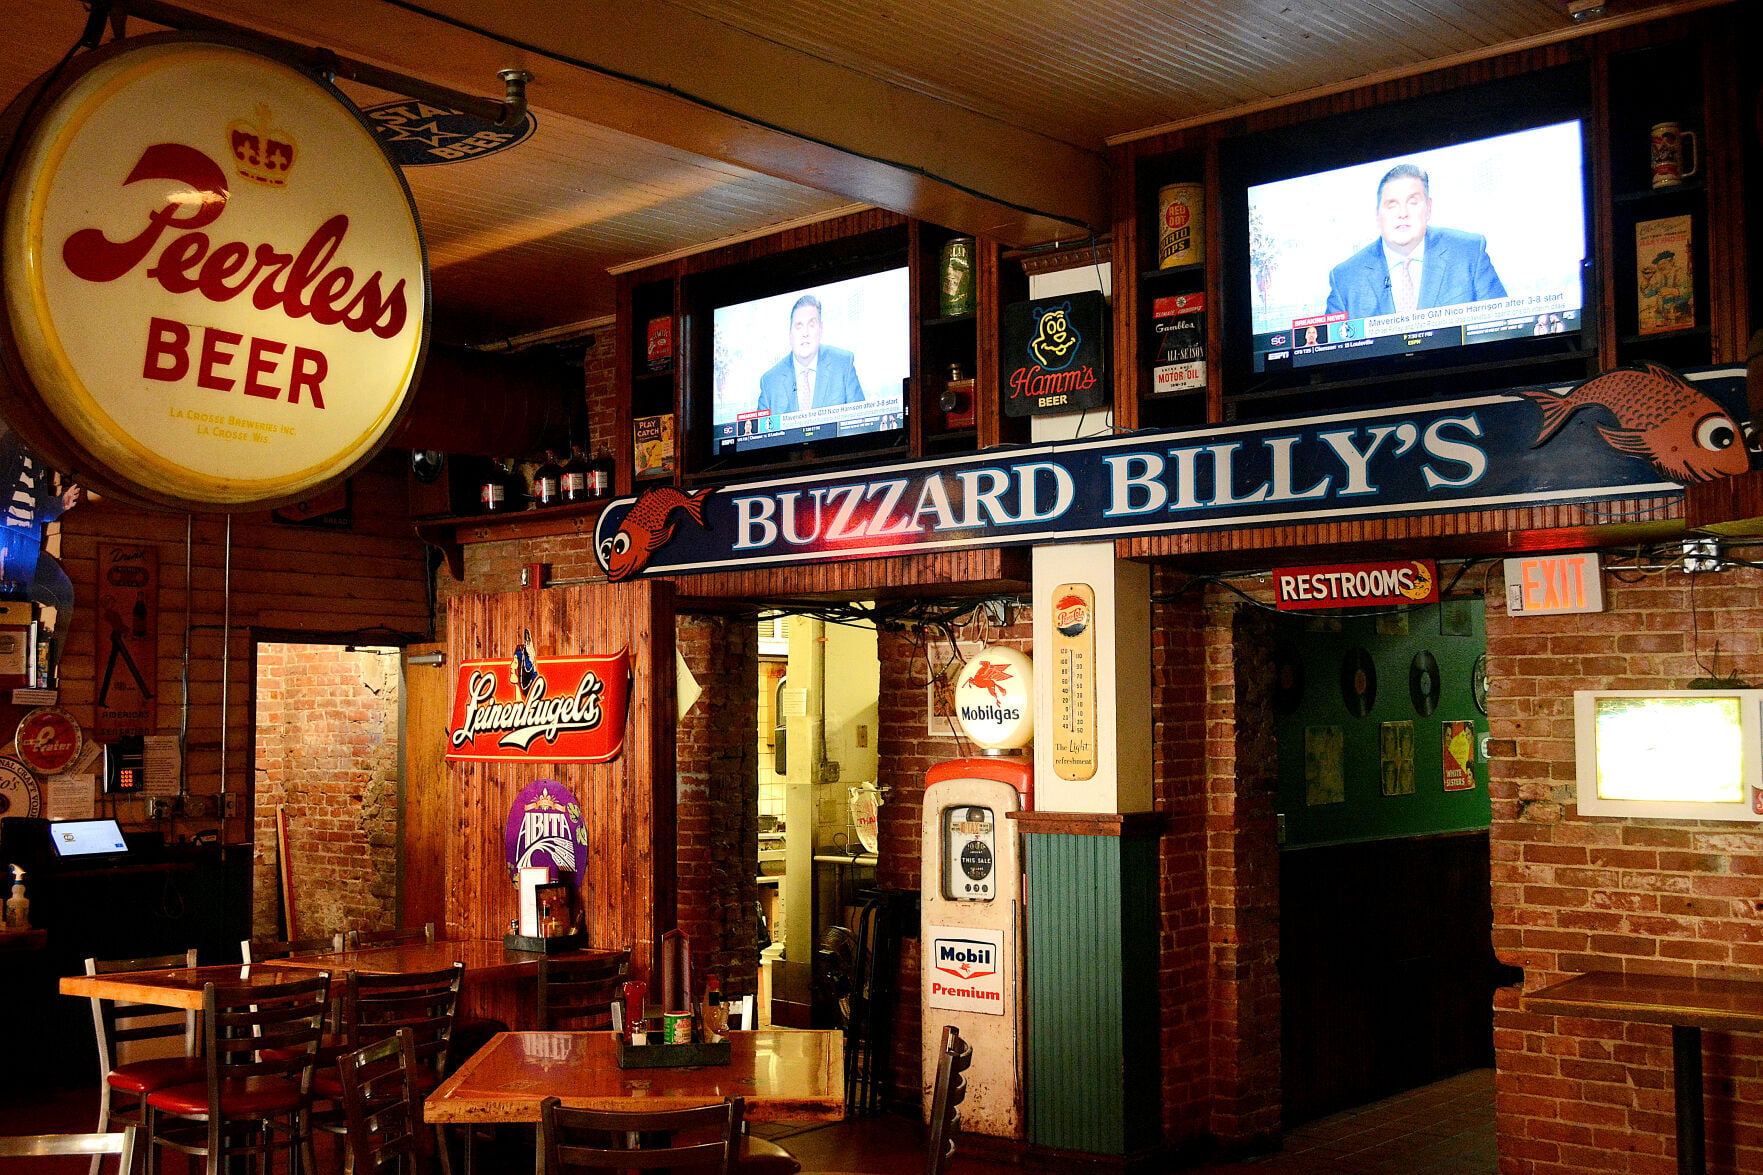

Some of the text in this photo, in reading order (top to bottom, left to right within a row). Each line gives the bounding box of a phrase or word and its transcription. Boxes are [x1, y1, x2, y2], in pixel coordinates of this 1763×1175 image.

[428, 131, 515, 159] BEER
[63, 143, 408, 339] Peerless
[1369, 292, 1564, 327] Mavericks fire GM Nico Harrison after 3-8 start
[142, 316, 329, 410] BEER
[1268, 350, 1290, 360] ESPN
[1010, 365, 1098, 398] Hamm's
[1158, 369, 1200, 384] MOTOR OIL
[1038, 395, 1069, 408] BEER
[637, 427, 659, 438] CATCH
[639, 420, 656, 429] PLAY
[732, 412, 1489, 551] BUZZARD BILLY'S
[1279, 567, 1416, 601] RESTROOMS
[1519, 557, 1588, 611] EXIT
[452, 671, 603, 745] Leinenkugel's
[961, 705, 1020, 724] Mobilgas
[1055, 739, 1092, 754] The Light
[1055, 757, 1092, 765] refreshment
[17, 766, 38, 793] CRAFT
[515, 812, 573, 862] ABITA
[940, 946, 991, 964] Mobil
[932, 983, 1000, 1001] Premium
